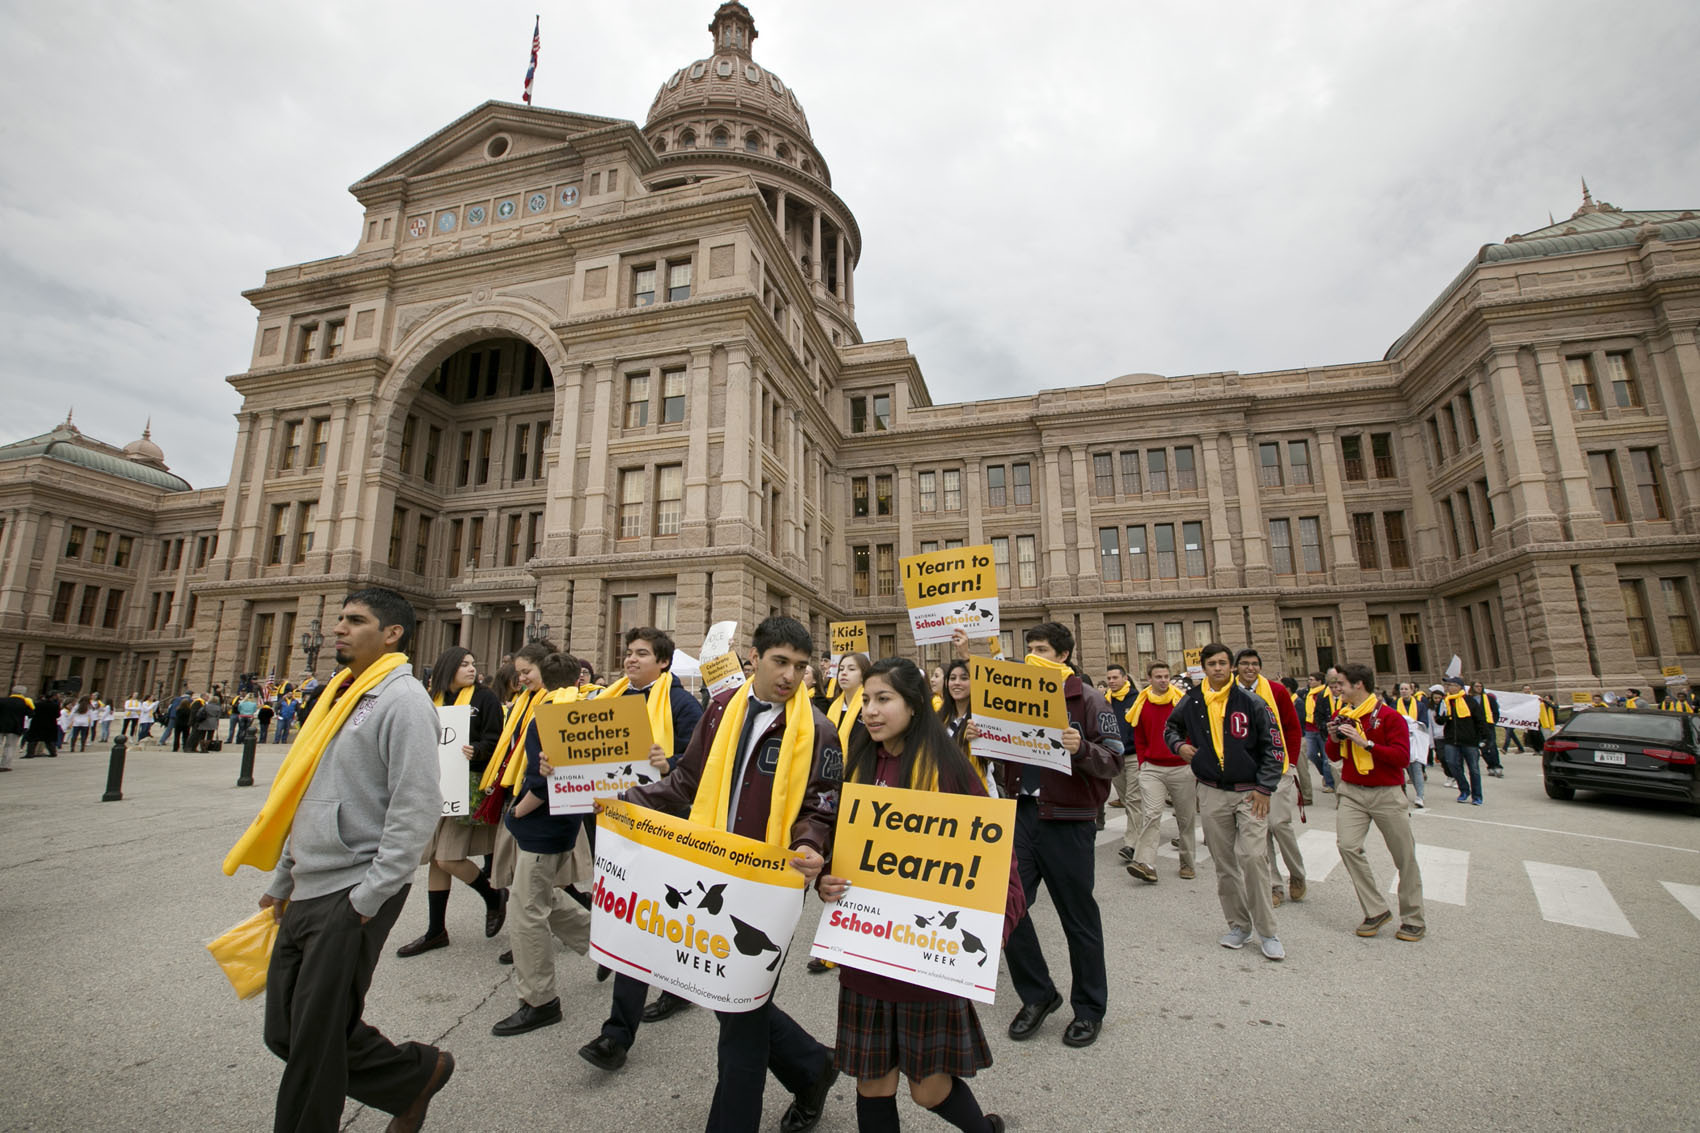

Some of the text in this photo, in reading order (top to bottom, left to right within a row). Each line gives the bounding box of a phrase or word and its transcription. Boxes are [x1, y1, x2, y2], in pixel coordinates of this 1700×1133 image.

[906, 555, 989, 578] I Yearn to
[918, 573, 981, 599] Learn!
[837, 625, 864, 638] Kids
[975, 665, 1057, 693] I Yearn to
[567, 708, 615, 725] Great
[983, 689, 1049, 719] Learn!
[558, 725, 630, 743] Teachers
[1231, 712, 1248, 739] C
[567, 741, 630, 762] Inspire!
[848, 798, 1003, 844] I Yearn to
[604, 805, 786, 872] Celebrating effective education options!
[859, 839, 982, 890] Learn!
[592, 875, 731, 960] choolChoice
[836, 899, 881, 916] NATIONAL
[829, 909, 960, 955] SchoolChoice
[676, 949, 727, 978] WEEK
[922, 951, 957, 967] WEEK
[653, 971, 752, 1005] www.schoolchoiceweek.com
